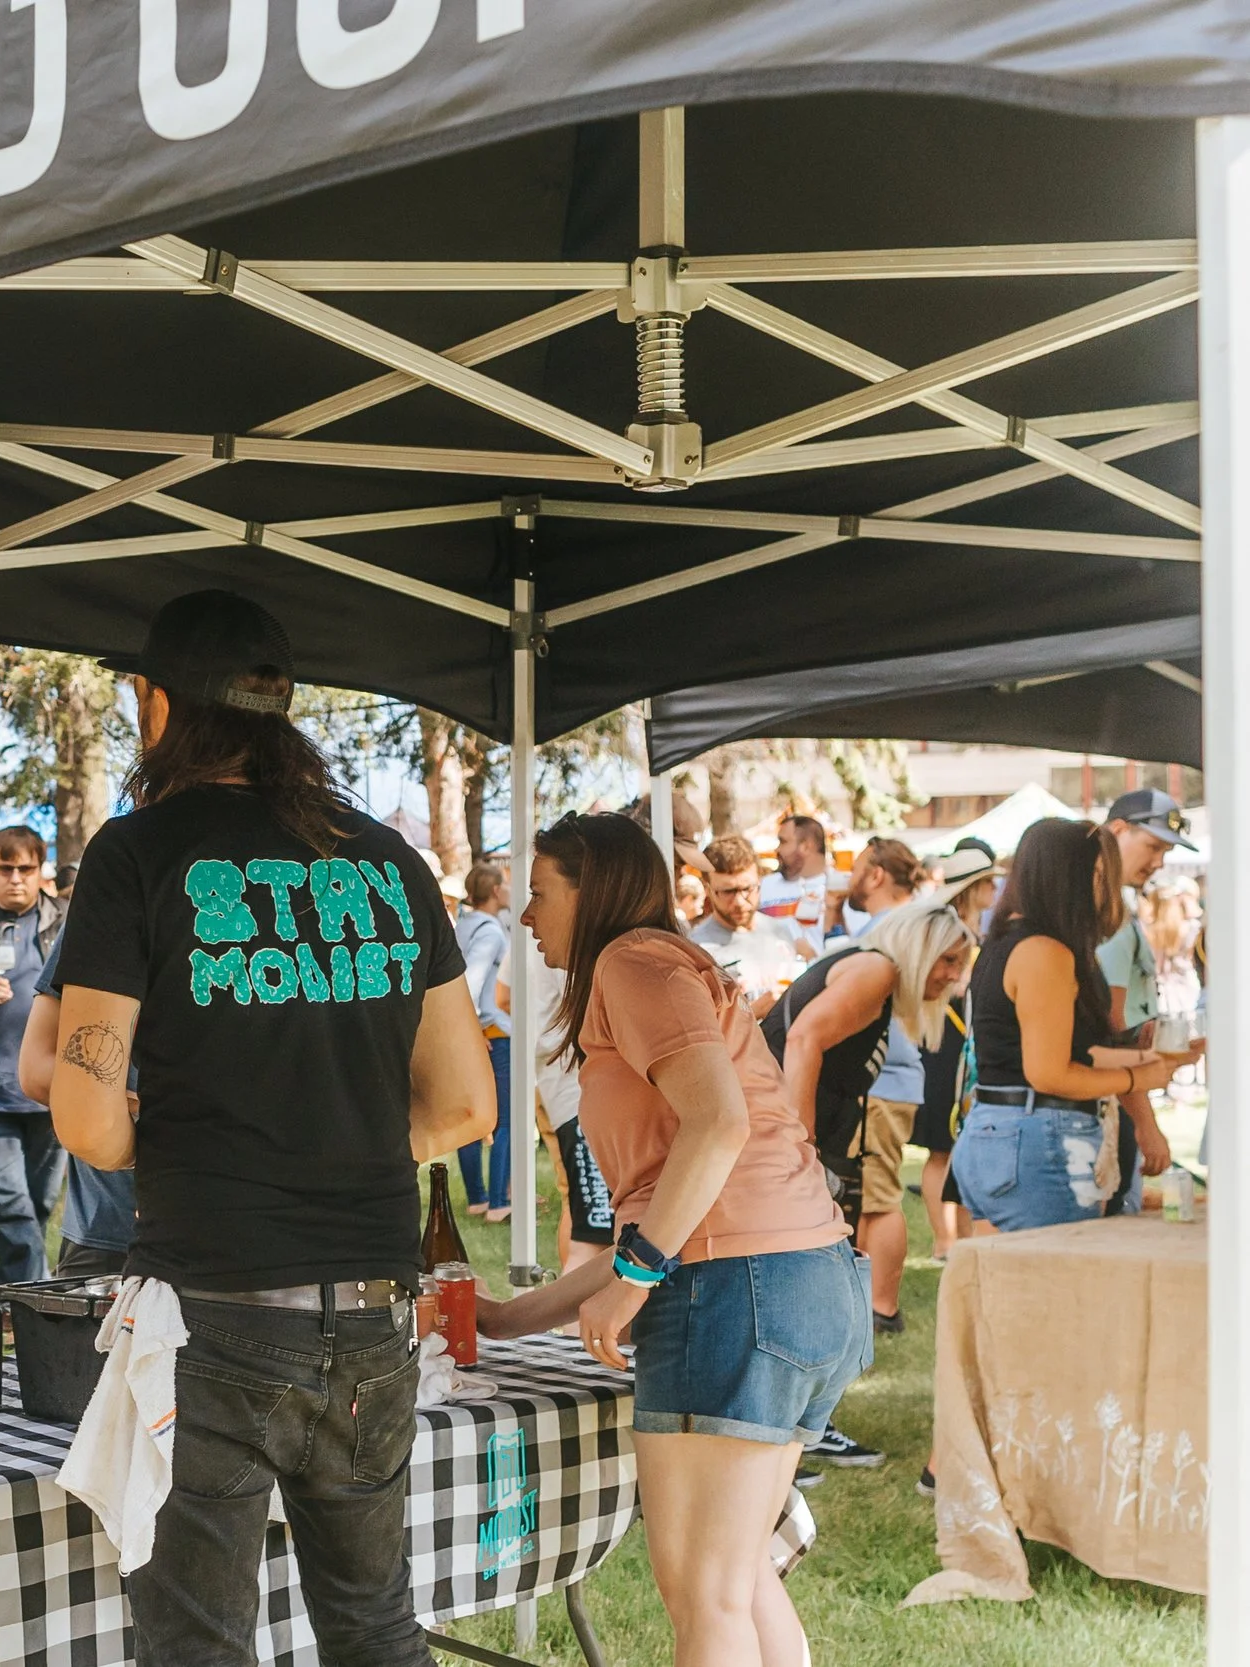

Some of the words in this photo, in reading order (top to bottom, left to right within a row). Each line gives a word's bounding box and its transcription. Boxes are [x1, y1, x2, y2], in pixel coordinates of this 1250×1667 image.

[185, 858, 414, 944] STAY
[478, 1489, 537, 1564] MODIST
[482, 1550, 521, 1581] BREWING
